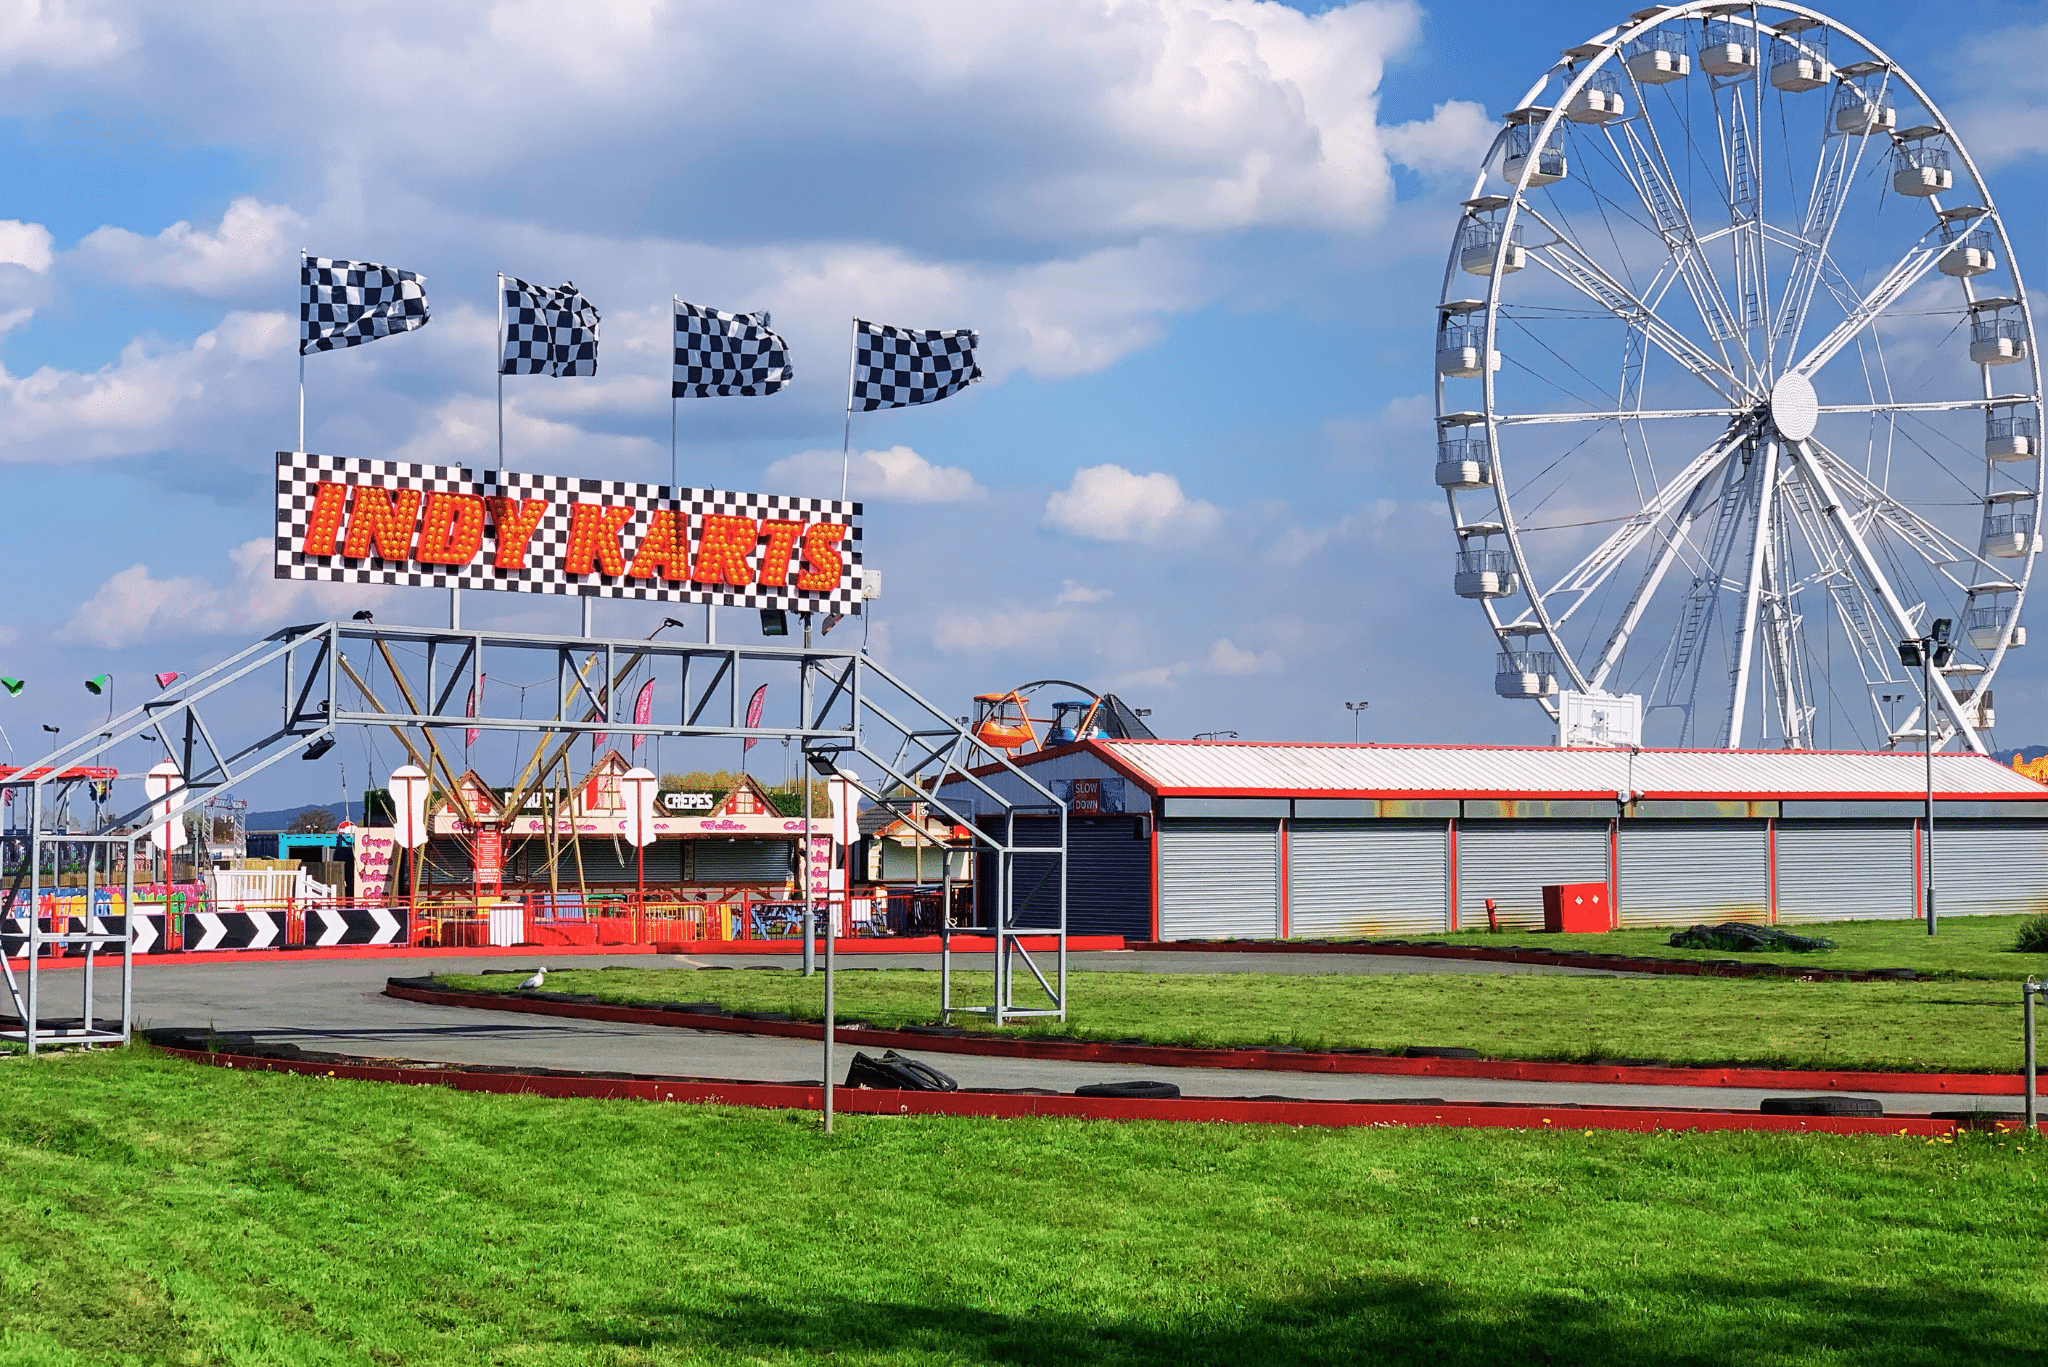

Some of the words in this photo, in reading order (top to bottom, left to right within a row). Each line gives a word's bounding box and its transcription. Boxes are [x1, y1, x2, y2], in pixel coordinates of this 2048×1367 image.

[302, 480, 549, 570] INDY
[563, 502, 847, 592] KARTS
[1075, 783, 1098, 794] SLOW
[1075, 800, 1098, 810] DOWN
